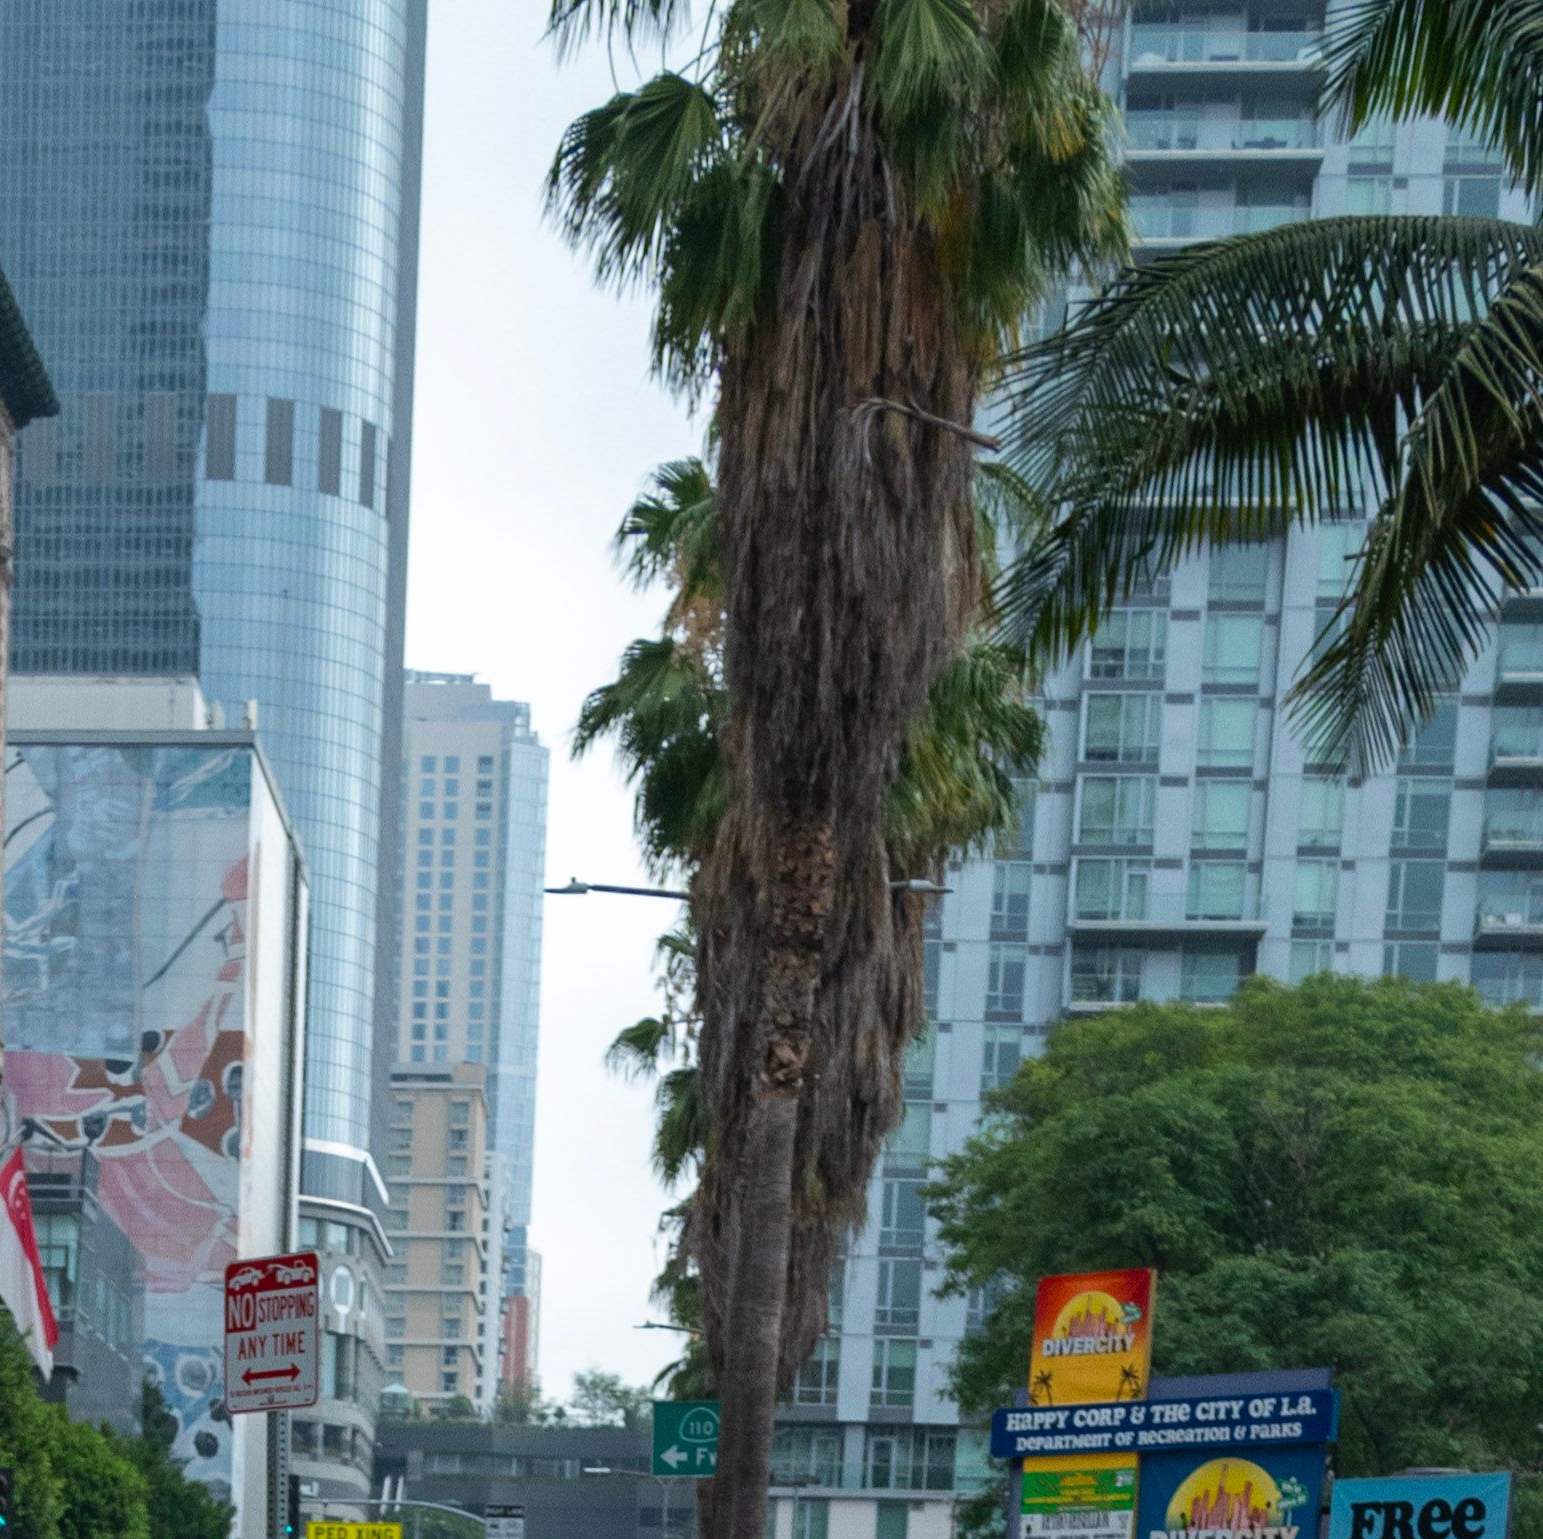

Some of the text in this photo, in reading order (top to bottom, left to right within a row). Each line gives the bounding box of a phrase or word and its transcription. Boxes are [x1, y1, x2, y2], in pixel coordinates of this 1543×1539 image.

[228, 1292, 315, 1329] NO STOPPING
[238, 1331, 305, 1360] ANY TIME
[1042, 1334, 1136, 1357] DIVERCITY
[1073, 1407, 1126, 1428] CORP
[1130, 1406, 1146, 1425] &
[1195, 1400, 1244, 1421] CITY
[1248, 1398, 1277, 1418] OF
[689, 1421, 714, 1436] 110
[1114, 1431, 1135, 1447] OF
[1234, 1425, 1247, 1440] &
